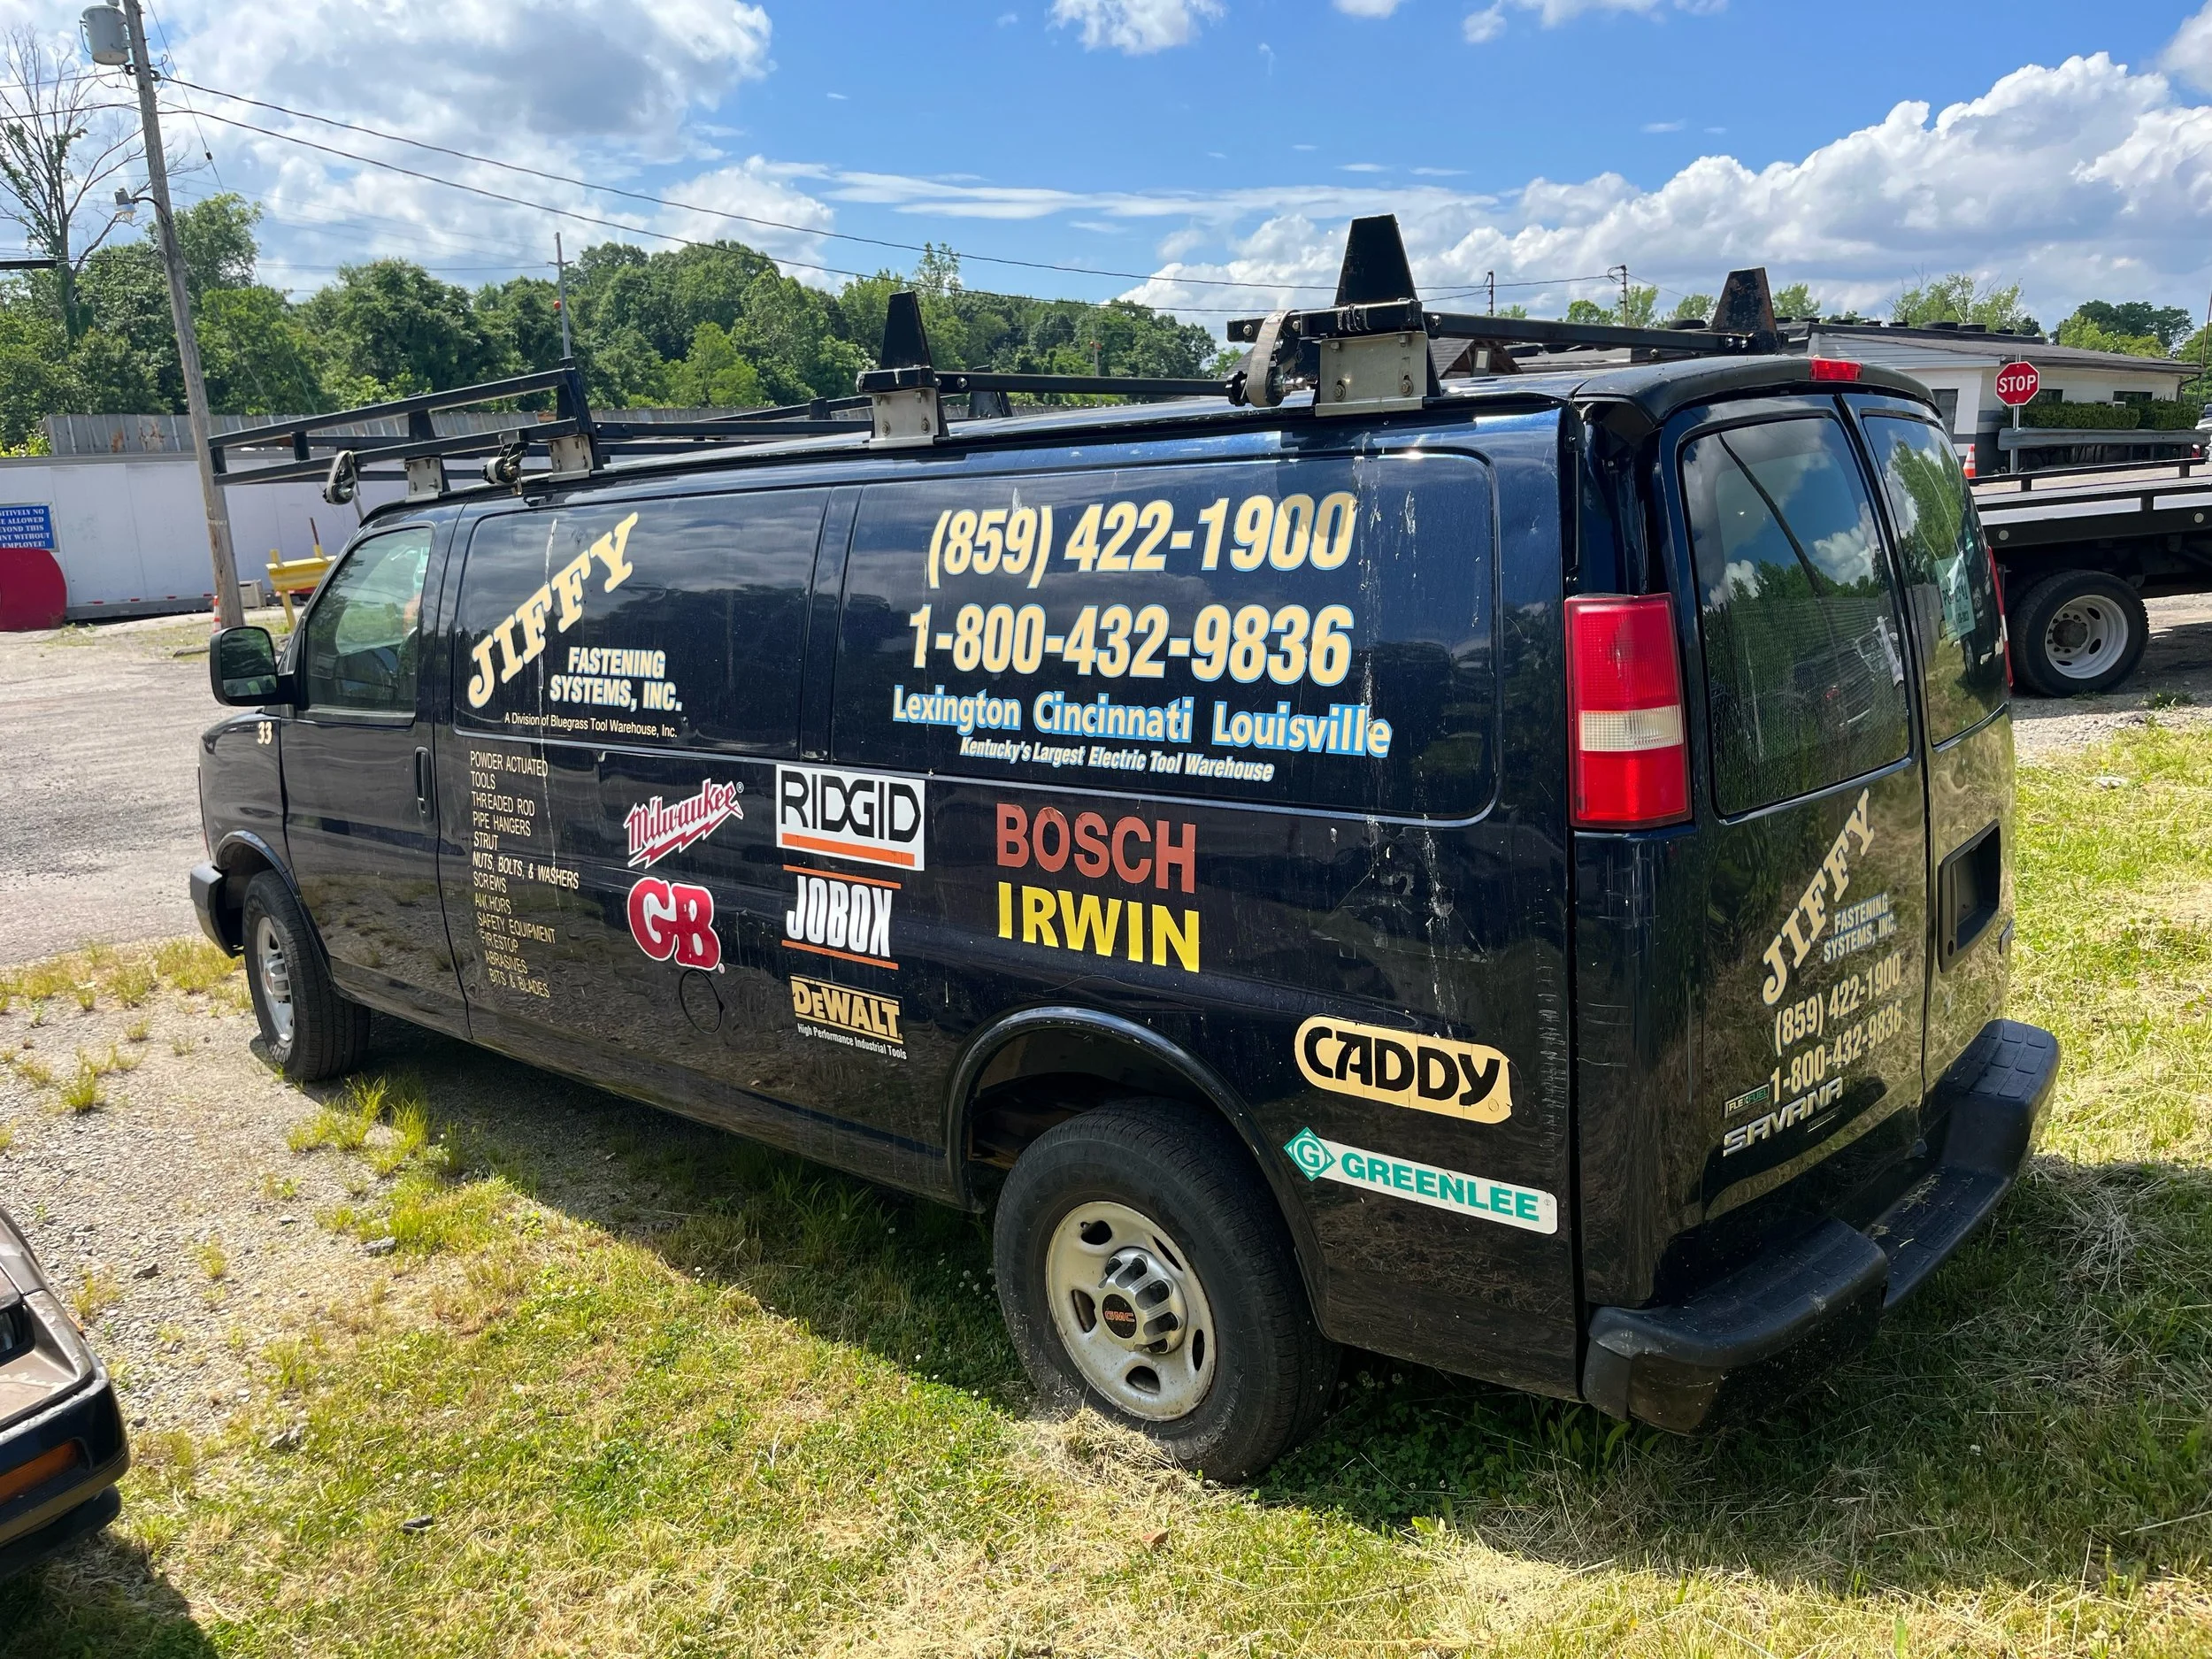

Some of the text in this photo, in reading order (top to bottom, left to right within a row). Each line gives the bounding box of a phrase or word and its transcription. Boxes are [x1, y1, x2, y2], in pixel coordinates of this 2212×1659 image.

[1998, 374, 2037, 393] STOP
[928, 492, 1358, 589] (859) 422-1900
[468, 511, 639, 708] JIFFY
[567, 646, 666, 679] FASTENING
[909, 603, 1356, 686] 1-800-432-9836
[549, 674, 683, 712] SYSTEMS, INC.
[257, 721, 273, 745] 33
[504, 711, 678, 738] A Division of Bluegrass Tool Warehouse, Inc.
[893, 684, 1393, 758] Lexington Cincinnati Louisville
[470, 750, 549, 777] POWDER ACTUATED
[959, 736, 1275, 783] Kentucky's Largest Electric Tool Warehouse
[471, 771, 495, 790] TOOLS
[472, 790, 535, 817] THREADED ROD
[472, 810, 531, 837] PIPE HANGERS
[623, 778, 740, 856] Milwaukee
[781, 770, 922, 843] RIDGID
[473, 831, 498, 851] STRUT
[996, 803, 1196, 894] BOSCH
[472, 851, 579, 890] NUTS, BOLTS, & WASHERS
[473, 870, 507, 893] SCREWS
[475, 892, 511, 915] ANCHORS
[787, 875, 892, 957] JOBOX
[1762, 787, 1875, 1006] JIFFY
[1834, 892, 1889, 935] FASTENING
[477, 911, 556, 944] SAFETY EQUIPMENT
[480, 929, 518, 953] FIRESTOP
[627, 877, 721, 971] GB
[998, 881, 1199, 973] IRWIN
[1823, 912, 1898, 964] SYSTEMS, INC.
[485, 949, 527, 974] ABRASIVES
[489, 968, 550, 998] BITS & BLADES
[1775, 952, 1901, 1057] (859) 422-1900
[797, 1023, 907, 1060] High Performance Industrial Tools
[1770, 1000, 1902, 1104] 1-800-432-9836
[1303, 1026, 1501, 1107] CADDY
[1723, 1076, 1843, 1157] SAVANA
[1297, 1141, 1540, 1222] G GREENLEE
[1104, 1310, 1135, 1323] GMC
